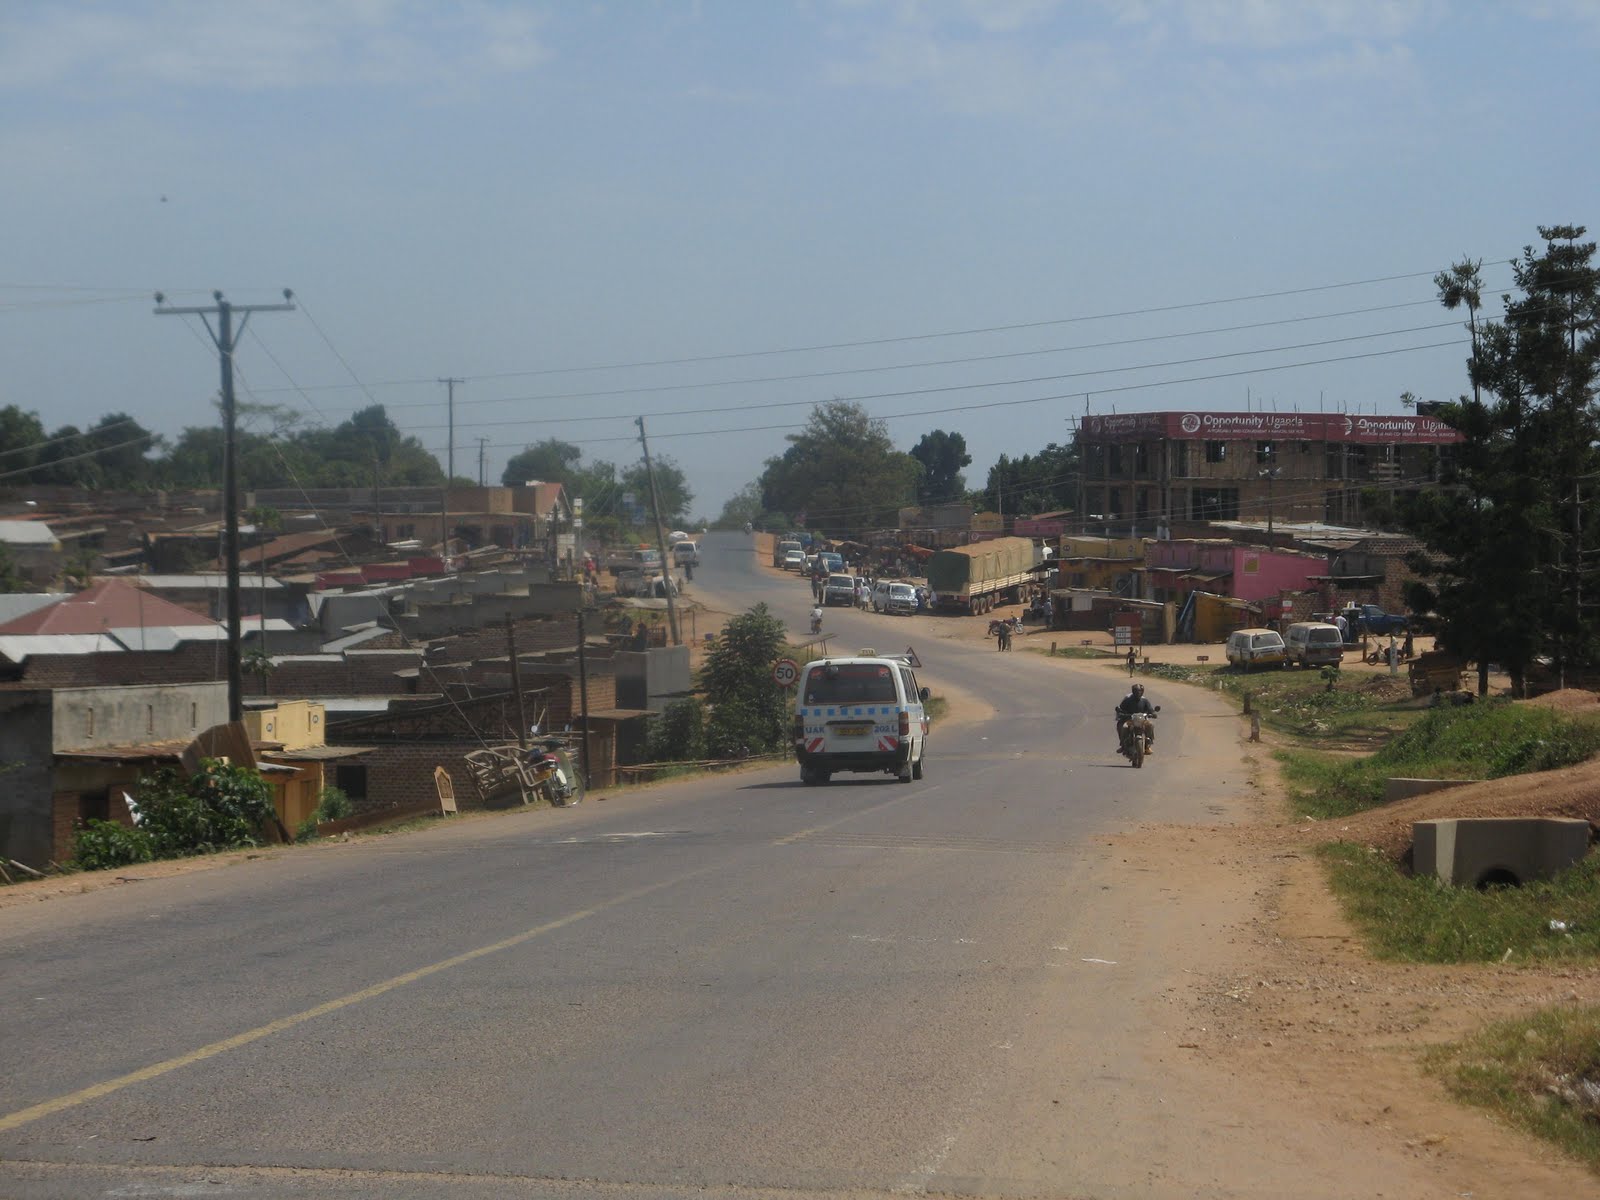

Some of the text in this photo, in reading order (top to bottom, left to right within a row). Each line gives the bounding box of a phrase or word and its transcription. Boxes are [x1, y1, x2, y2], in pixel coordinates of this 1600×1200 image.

[1203, 414, 1304, 429] Opportunity Uganda
[1358, 418, 1416, 432] Opportunity
[776, 667, 794, 680] 50
[805, 726, 825, 734] UAK
